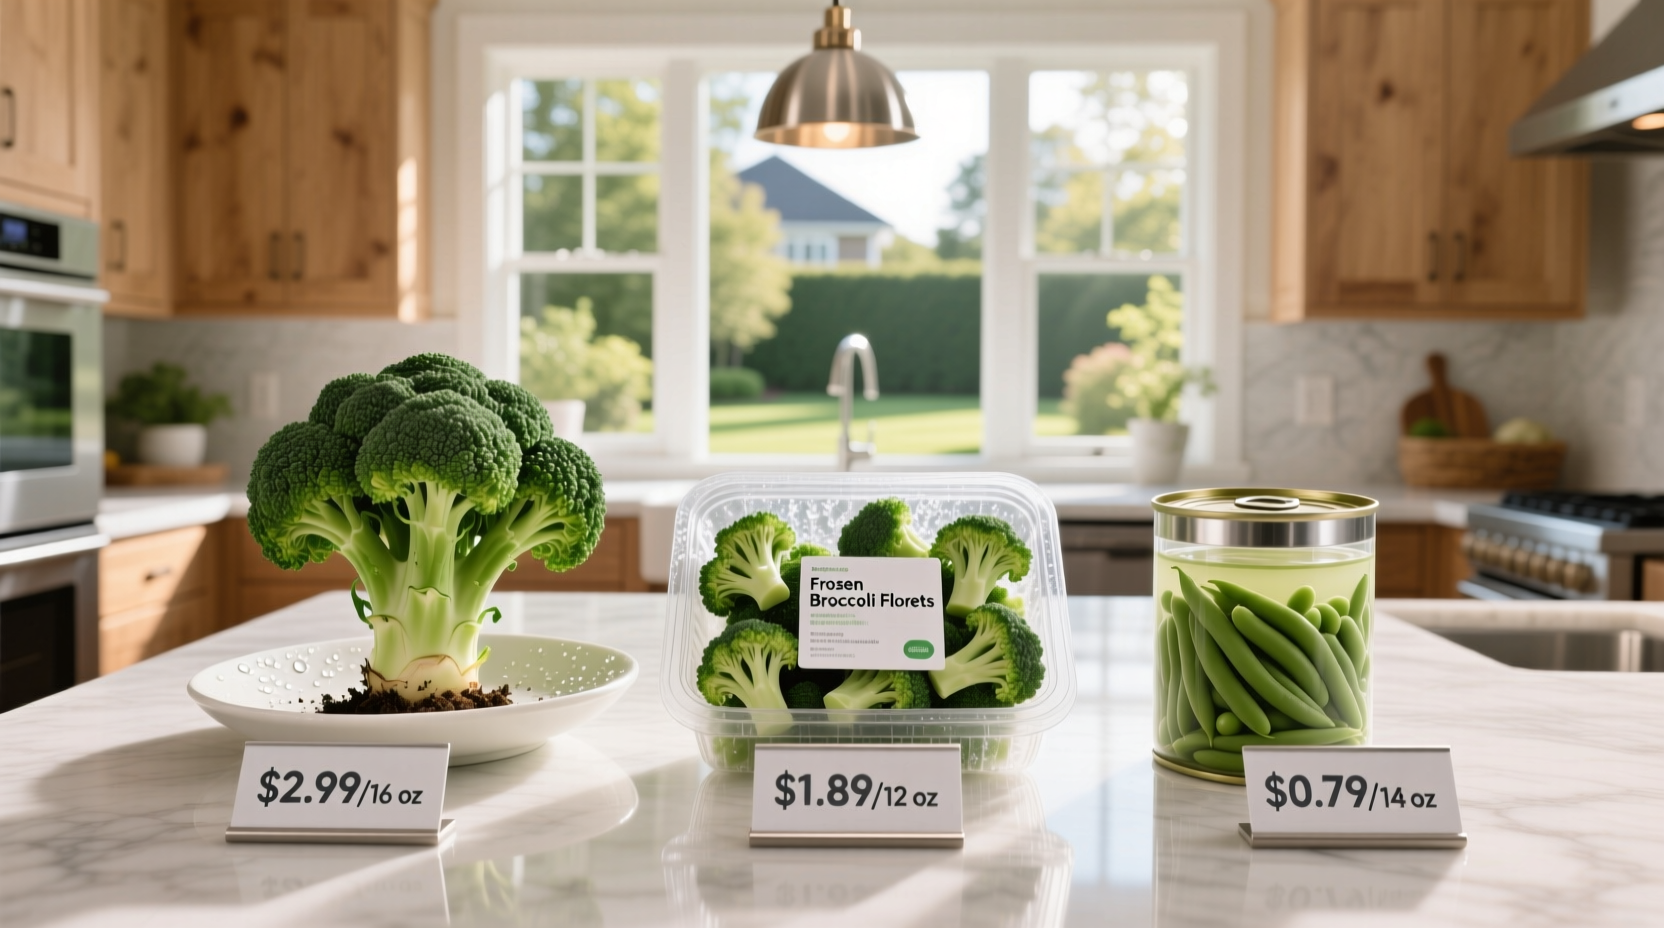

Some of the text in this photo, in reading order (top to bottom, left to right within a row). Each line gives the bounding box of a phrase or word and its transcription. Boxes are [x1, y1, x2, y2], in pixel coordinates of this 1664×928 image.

[810, 592, 935, 608] Broccoli Florets
[256, 766, 424, 808] $2.99/16 oz
[774, 769, 939, 811] $1.89/12 oz
[1264, 770, 1438, 812] $0.79/14 oz
